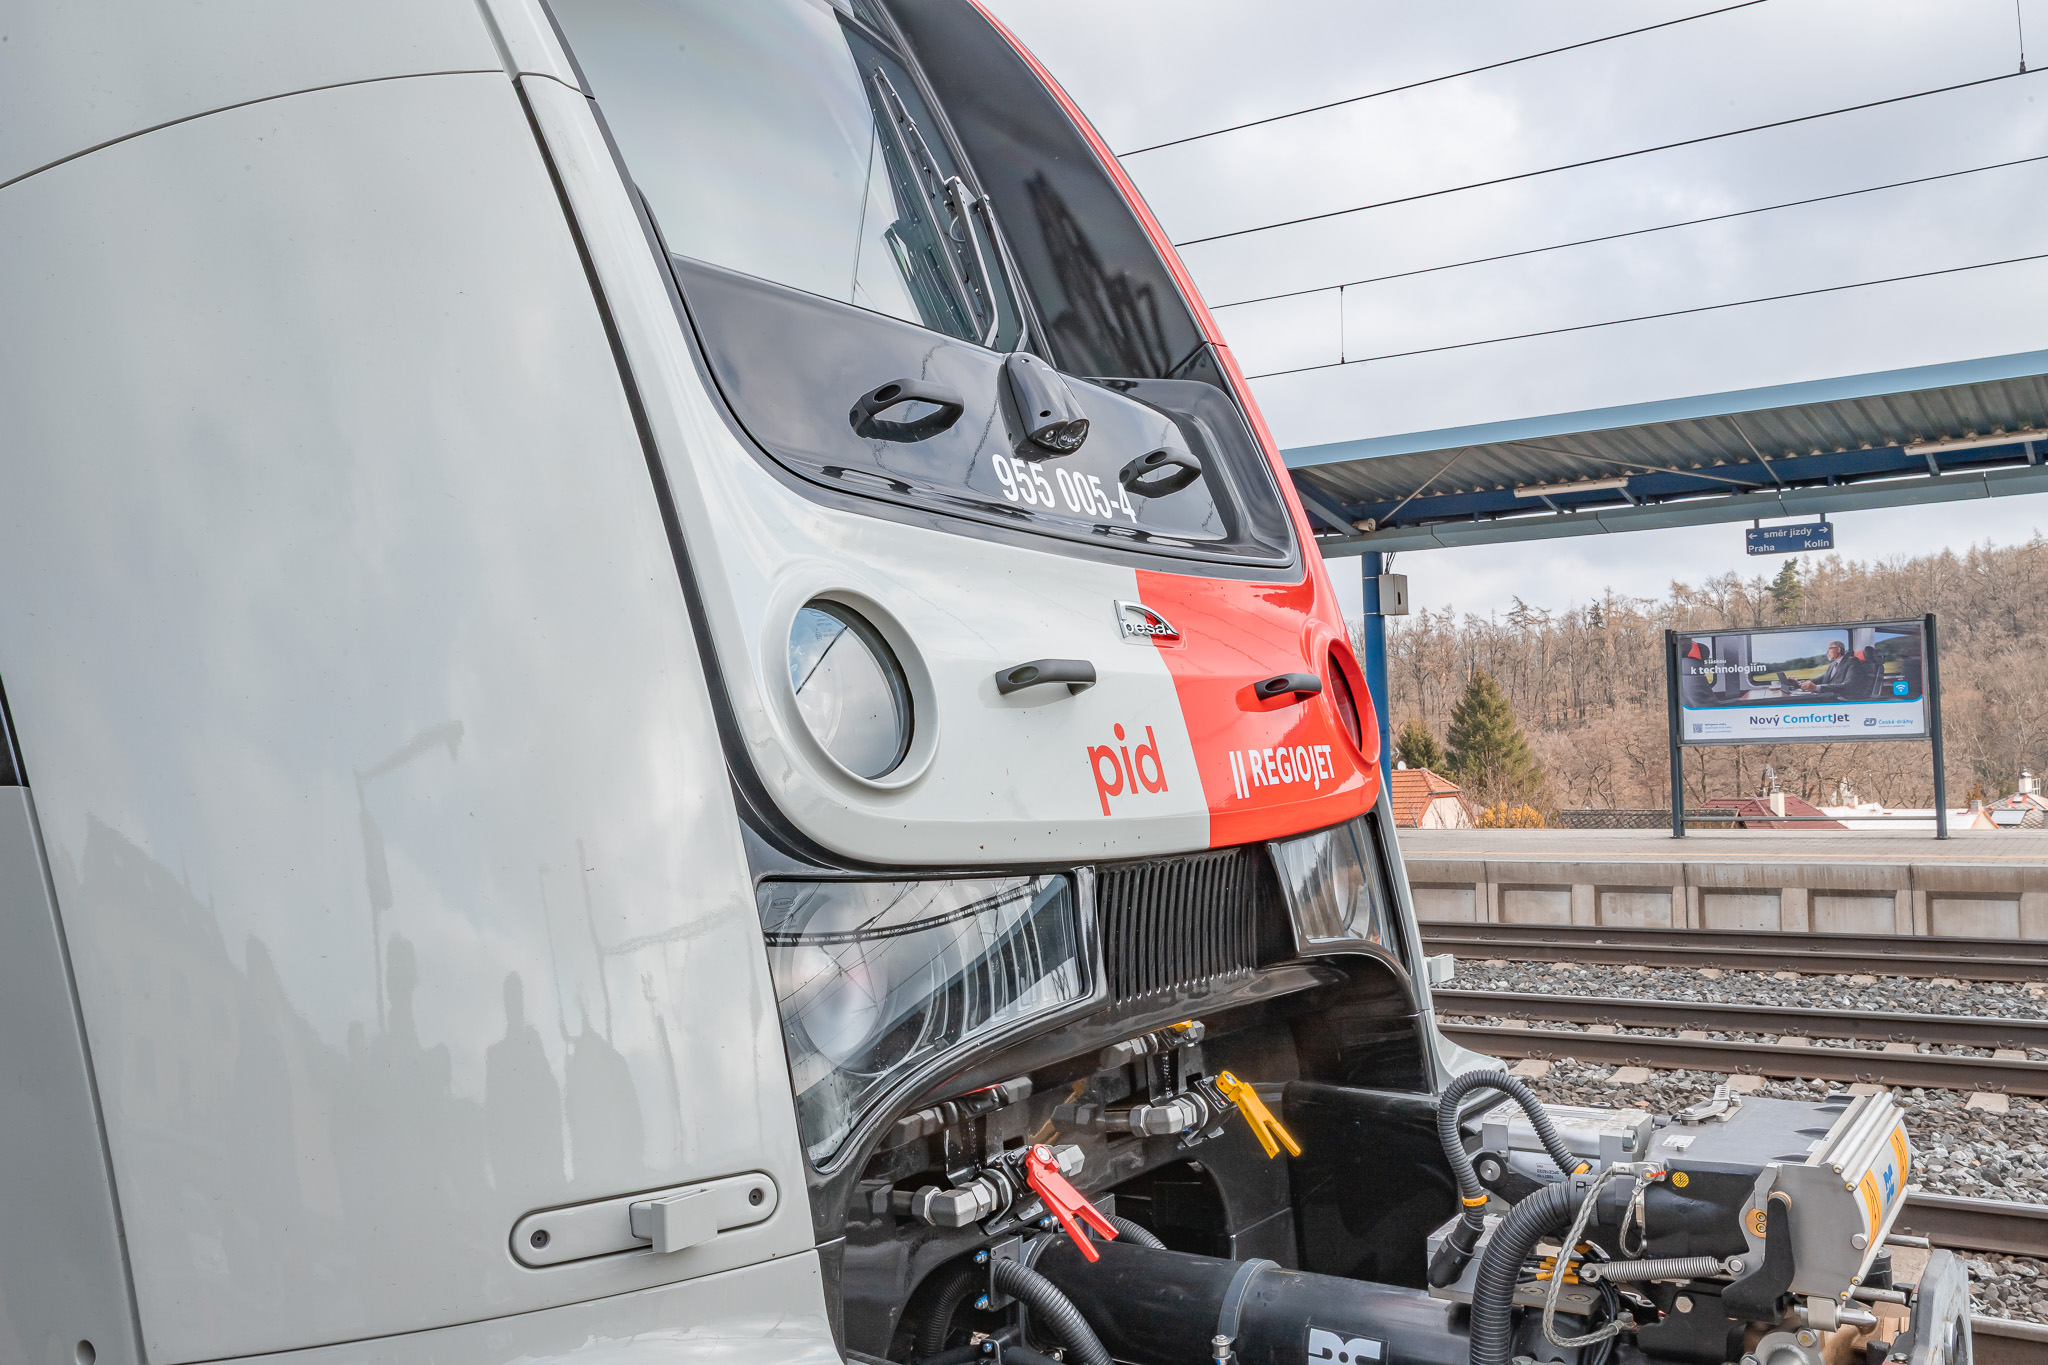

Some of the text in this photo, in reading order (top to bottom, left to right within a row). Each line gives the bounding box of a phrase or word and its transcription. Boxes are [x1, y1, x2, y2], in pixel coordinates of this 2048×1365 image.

[991, 453, 1138, 524] 955 005-4
[1764, 528, 1812, 538] směr jízdy
[1748, 539, 1829, 553] Praha Kolín
[1120, 621, 1167, 637] pesa
[1690, 662, 1767, 675] k technologiím
[1749, 713, 1850, 726] Nový ComfortJet
[1086, 722, 1169, 817] pid
[1248, 744, 1335, 790] REGIOJET
